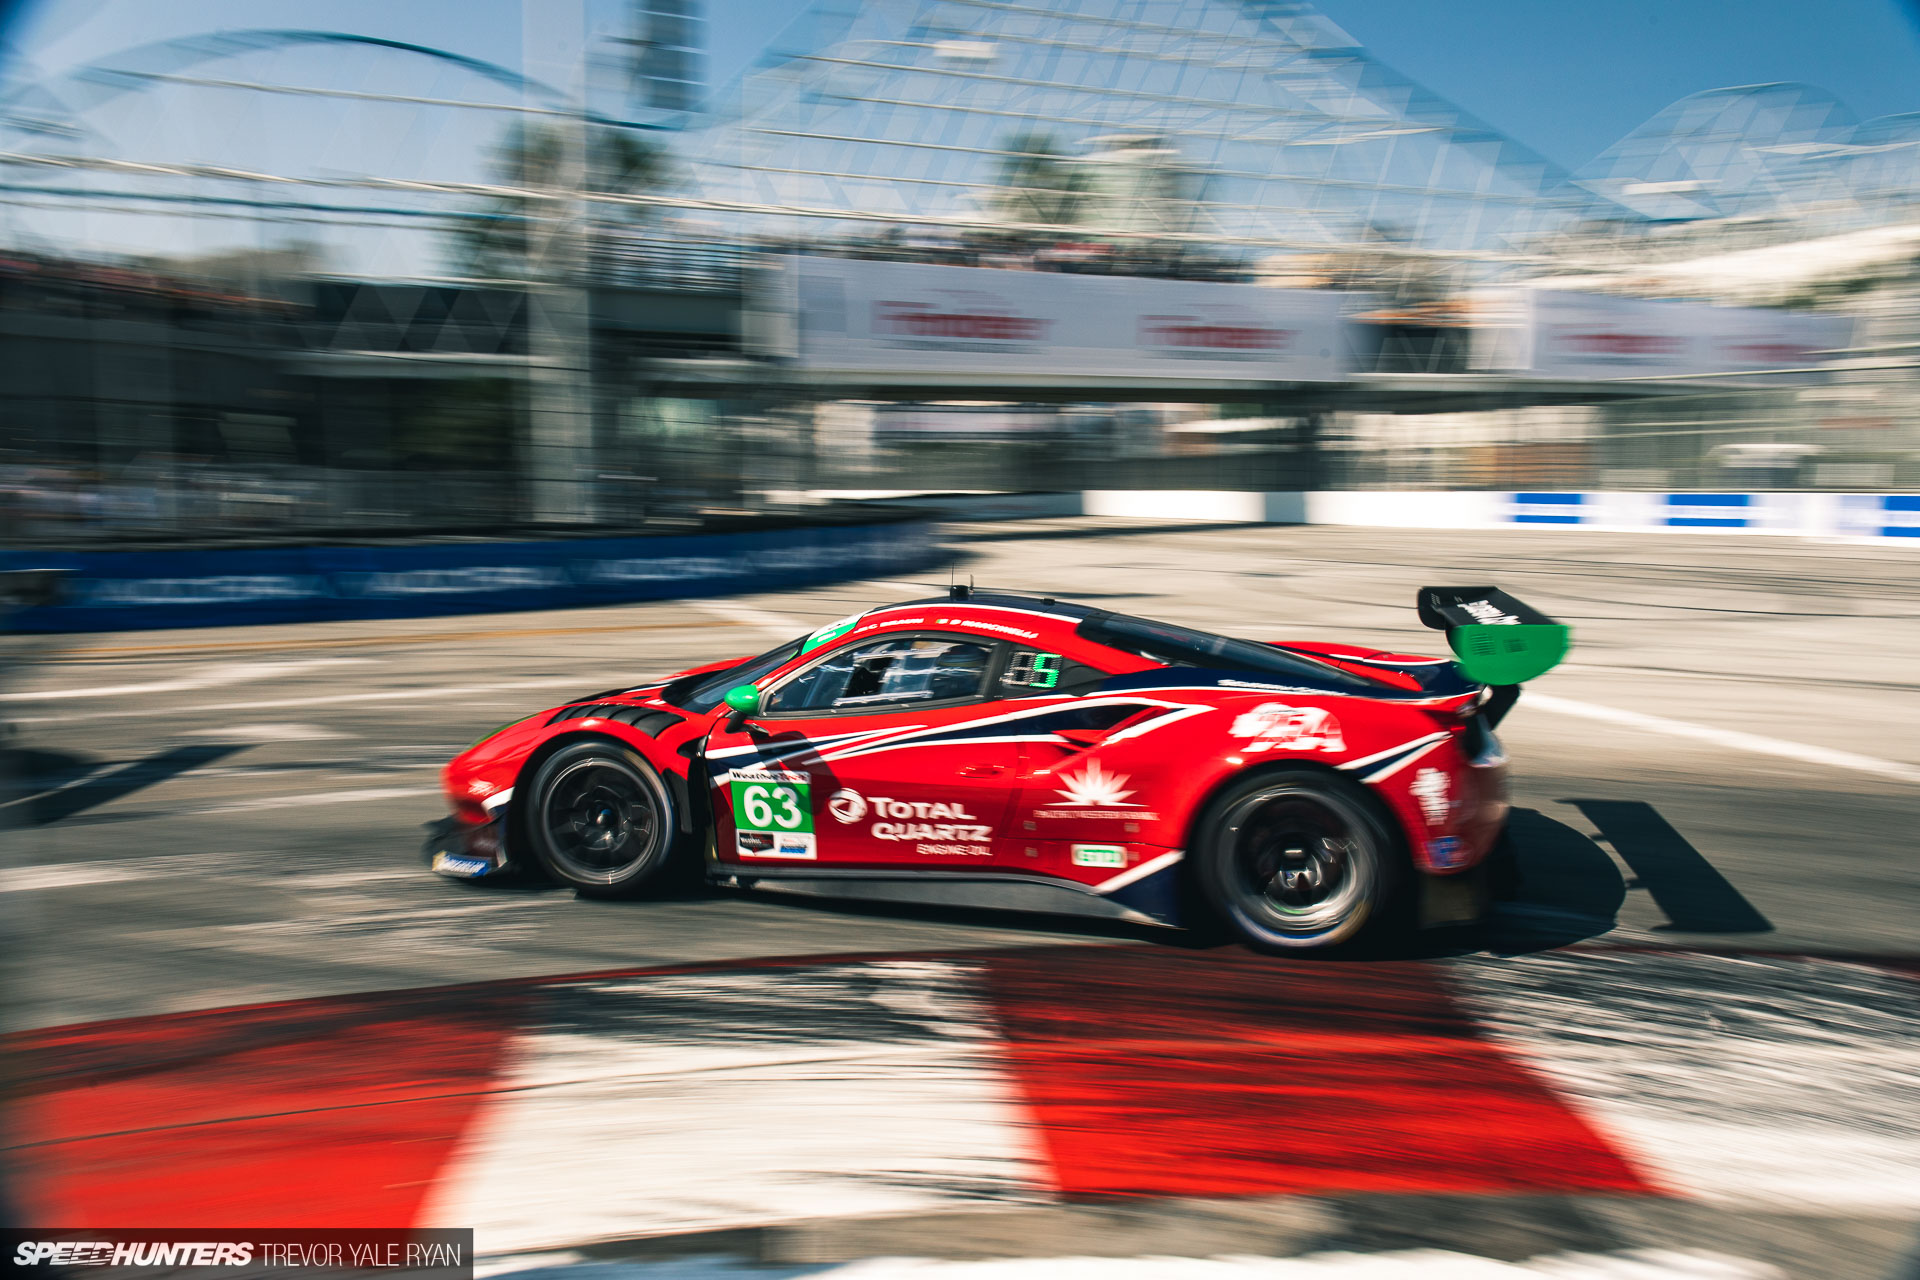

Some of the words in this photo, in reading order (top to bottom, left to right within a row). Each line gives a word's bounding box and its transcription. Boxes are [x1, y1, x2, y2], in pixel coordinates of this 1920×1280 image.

[743, 785, 803, 829] 63
[866, 796, 978, 820] TOTAL
[871, 822, 993, 842] QUARTZ
